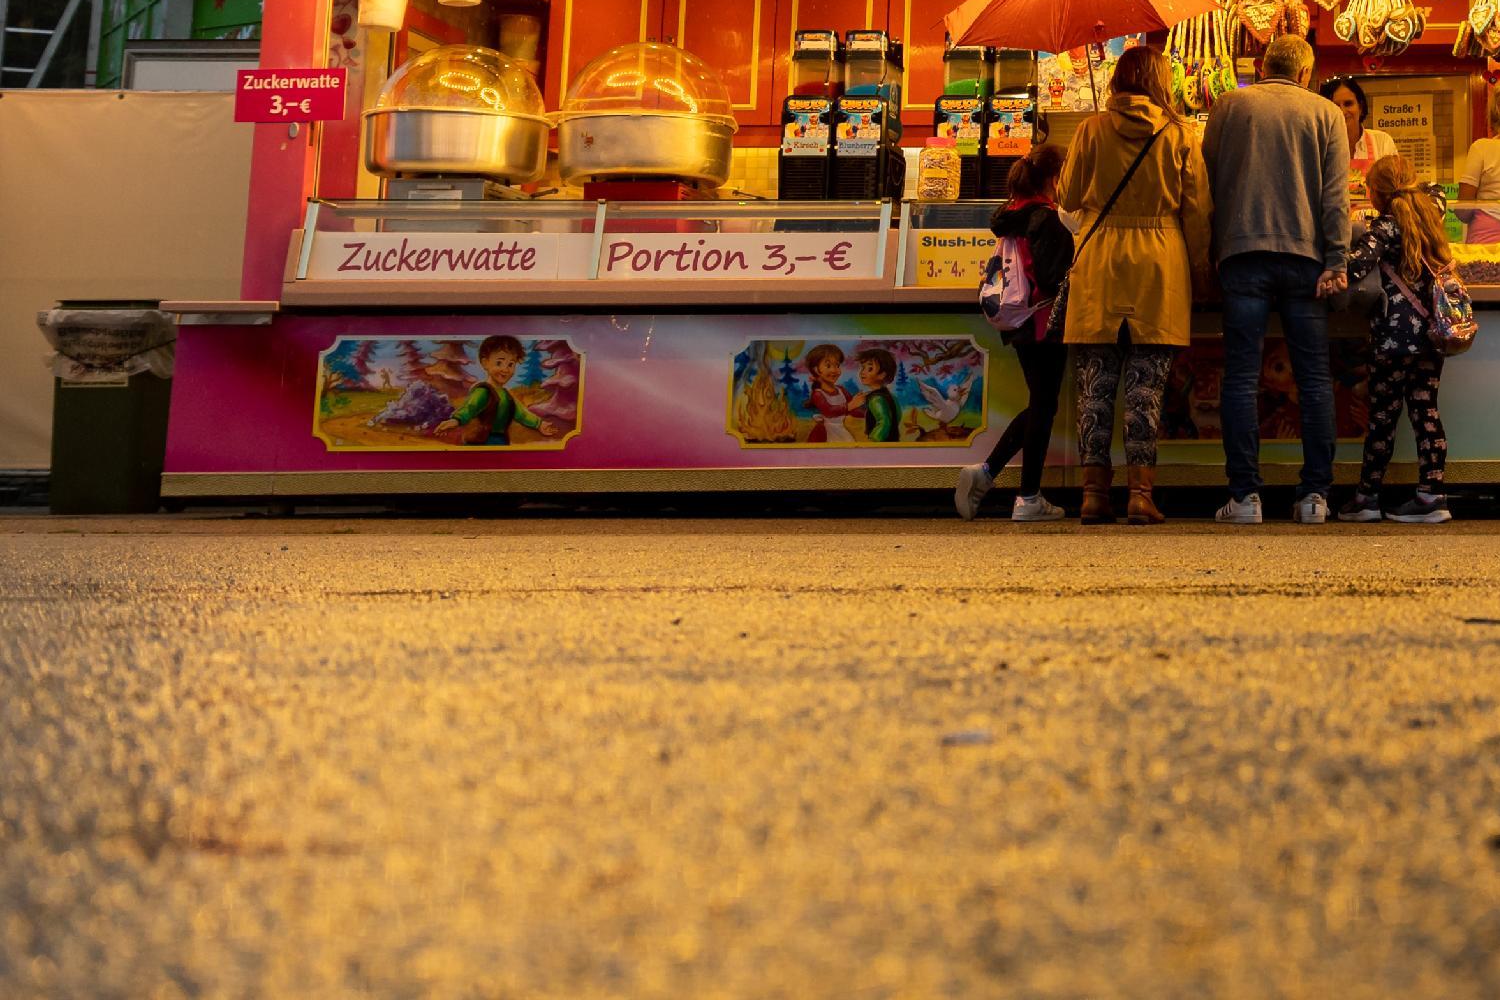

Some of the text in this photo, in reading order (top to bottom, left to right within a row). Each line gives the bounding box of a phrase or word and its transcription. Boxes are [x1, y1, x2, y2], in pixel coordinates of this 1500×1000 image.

[243, 74, 340, 90] Zuckerwatte
[1378, 117, 1418, 128] Geschäft
[921, 236, 997, 248] Slush-Ice
[337, 236, 537, 274] Zuckerwatte
[606, 239, 749, 274] Portion
